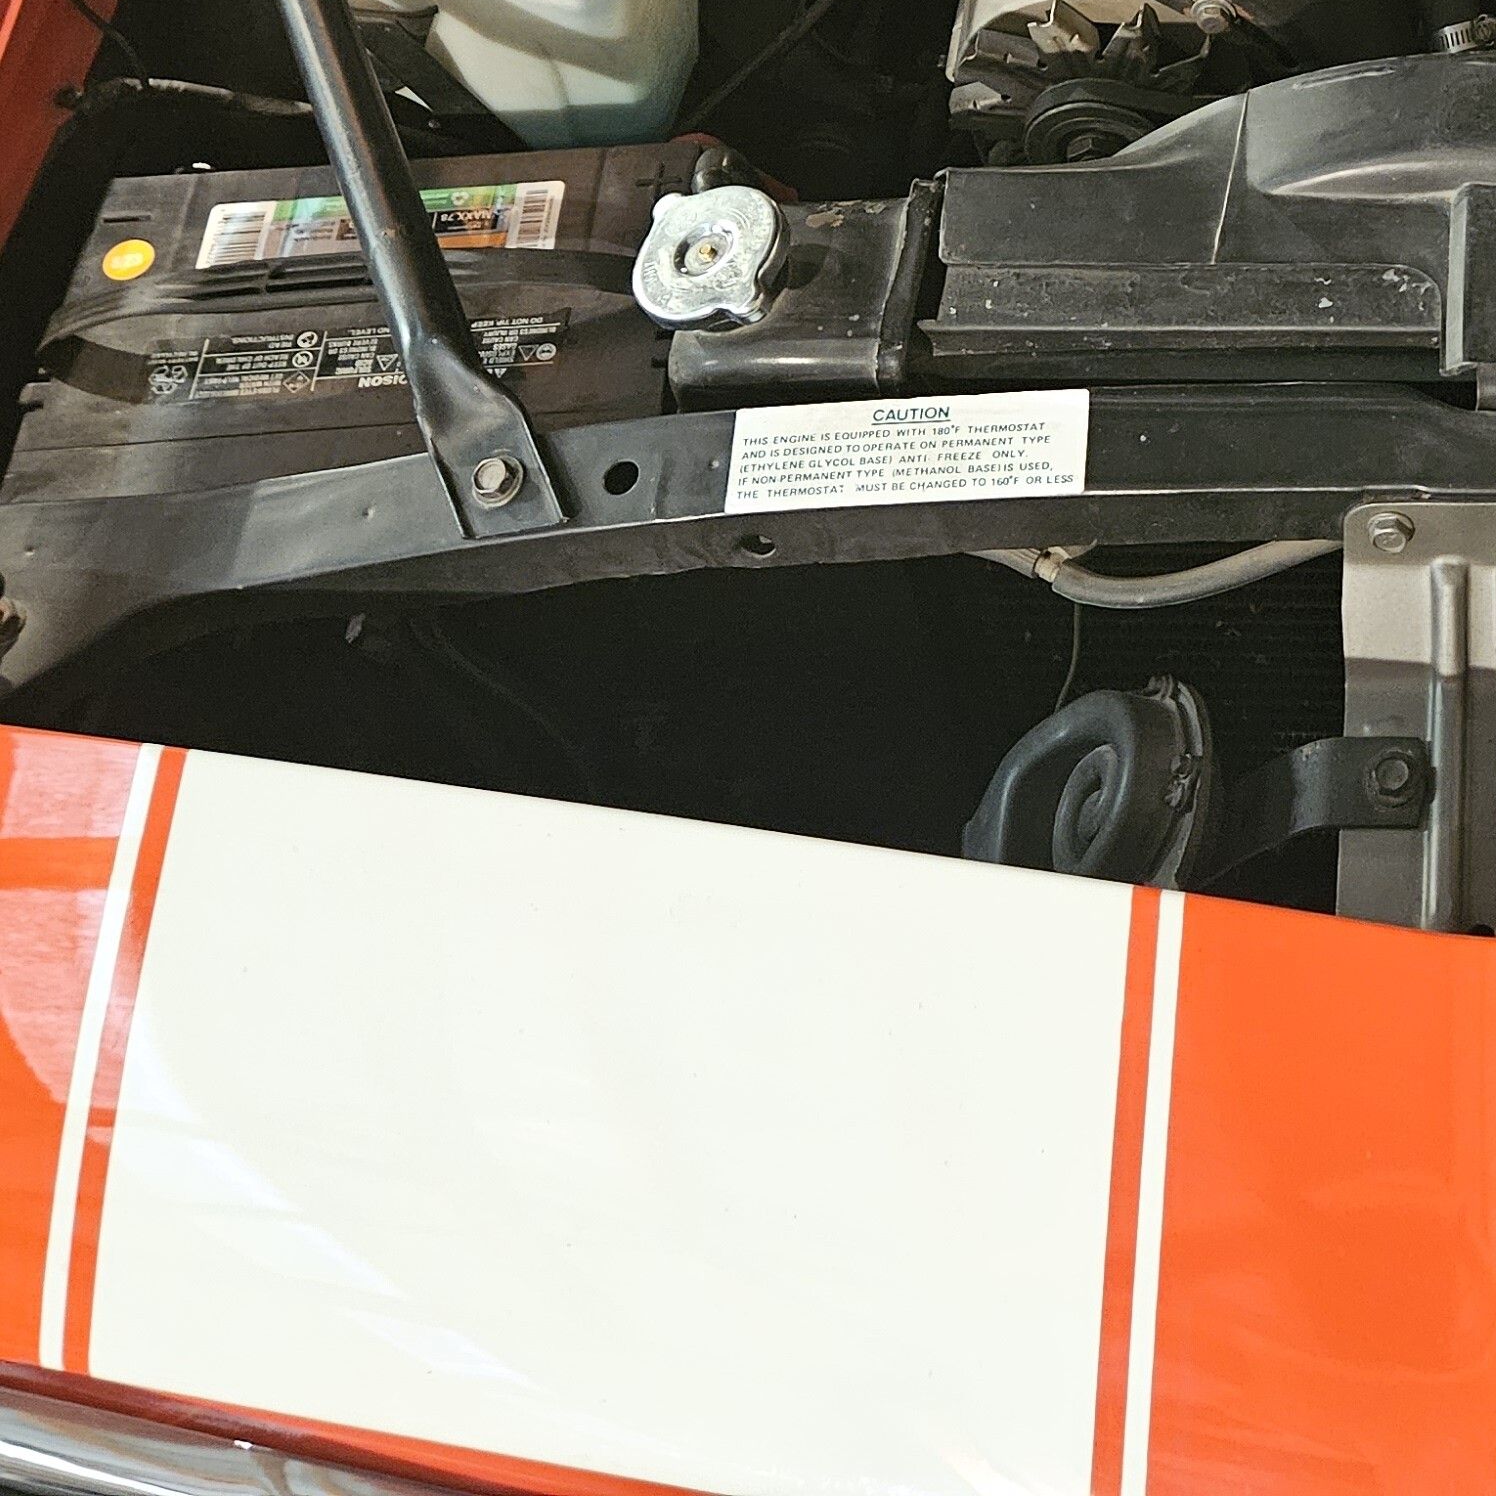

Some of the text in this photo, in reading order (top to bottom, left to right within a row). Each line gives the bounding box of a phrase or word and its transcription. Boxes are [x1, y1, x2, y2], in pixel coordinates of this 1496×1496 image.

[357, 376, 408, 388] OISON
[872, 404, 950, 422] CAUTION
[743, 437, 768, 445] THIS
[772, 434, 815, 444] ENGINE
[834, 429, 890, 440] EQUIPPED
[896, 428, 925, 436] WITH
[967, 421, 1045, 434] THERMOSTAT
[741, 434, 1051, 459] AND IS DESIGNED TO OPERATE ON PERMANENT TYPE
[739, 460, 805, 473] (ETHYLENE
[808, 458, 855, 468] GLYCOL
[859, 456, 892, 466] BASE)
[937, 451, 982, 461] FREEZE
[991, 448, 1028, 459] ONLY.
[738, 477, 748, 485] IF
[856, 469, 884, 478] TYPE
[892, 464, 961, 477] (METHANOL
[967, 463, 1001, 473] BASE)
[1003, 463, 1013, 471] IS
[1019, 461, 1053, 472] USED,
[736, 490, 758, 499] THE
[855, 482, 887, 492] MUST
[891, 482, 904, 490] BE
[909, 478, 966, 490] CHANGED
[972, 478, 986, 486] TO
[1026, 476, 1042, 484] OR
[1046, 474, 1074, 484] LESS
